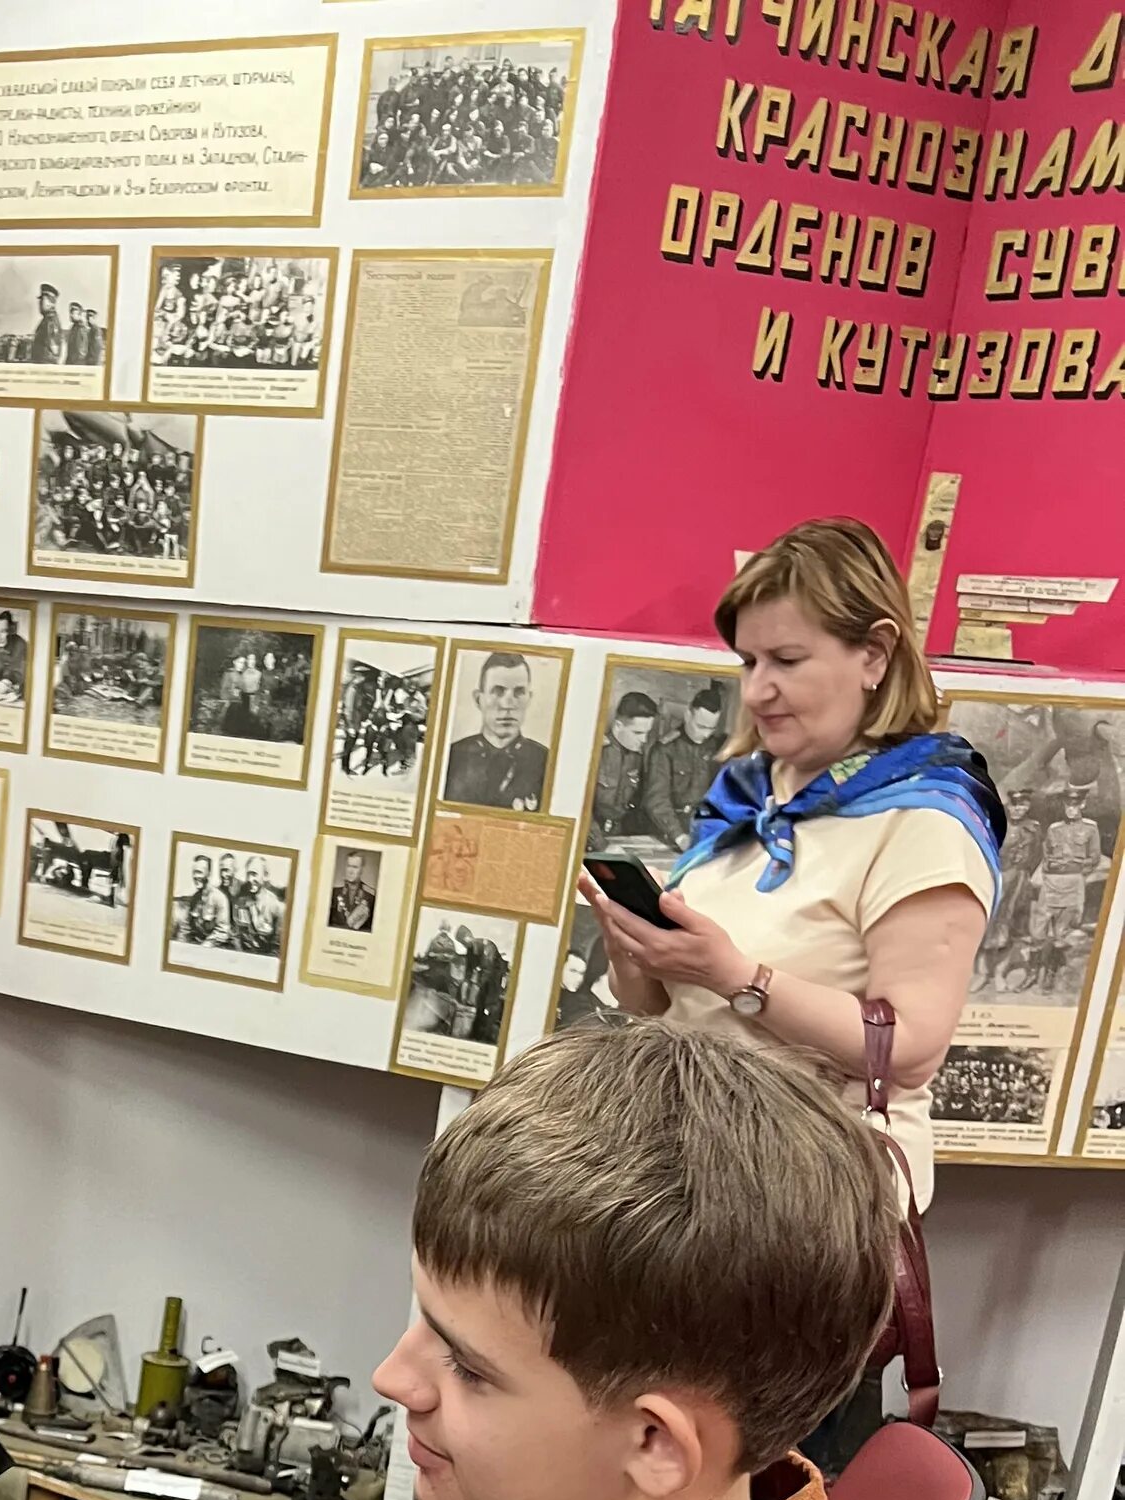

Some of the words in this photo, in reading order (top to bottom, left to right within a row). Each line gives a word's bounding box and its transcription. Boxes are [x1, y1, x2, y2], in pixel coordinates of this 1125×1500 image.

[650, 0, 1036, 98] ТЧИНСКАЯ
[1069, 11, 1124, 92] Д
[716, 77, 1125, 201] КРАСНОЗНАМ
[660, 183, 935, 297] ОРДЕНОВ
[985, 223, 1125, 300] СУВ
[751, 305, 793, 382] И
[817, 315, 1125, 401] КУТУЗОВА
